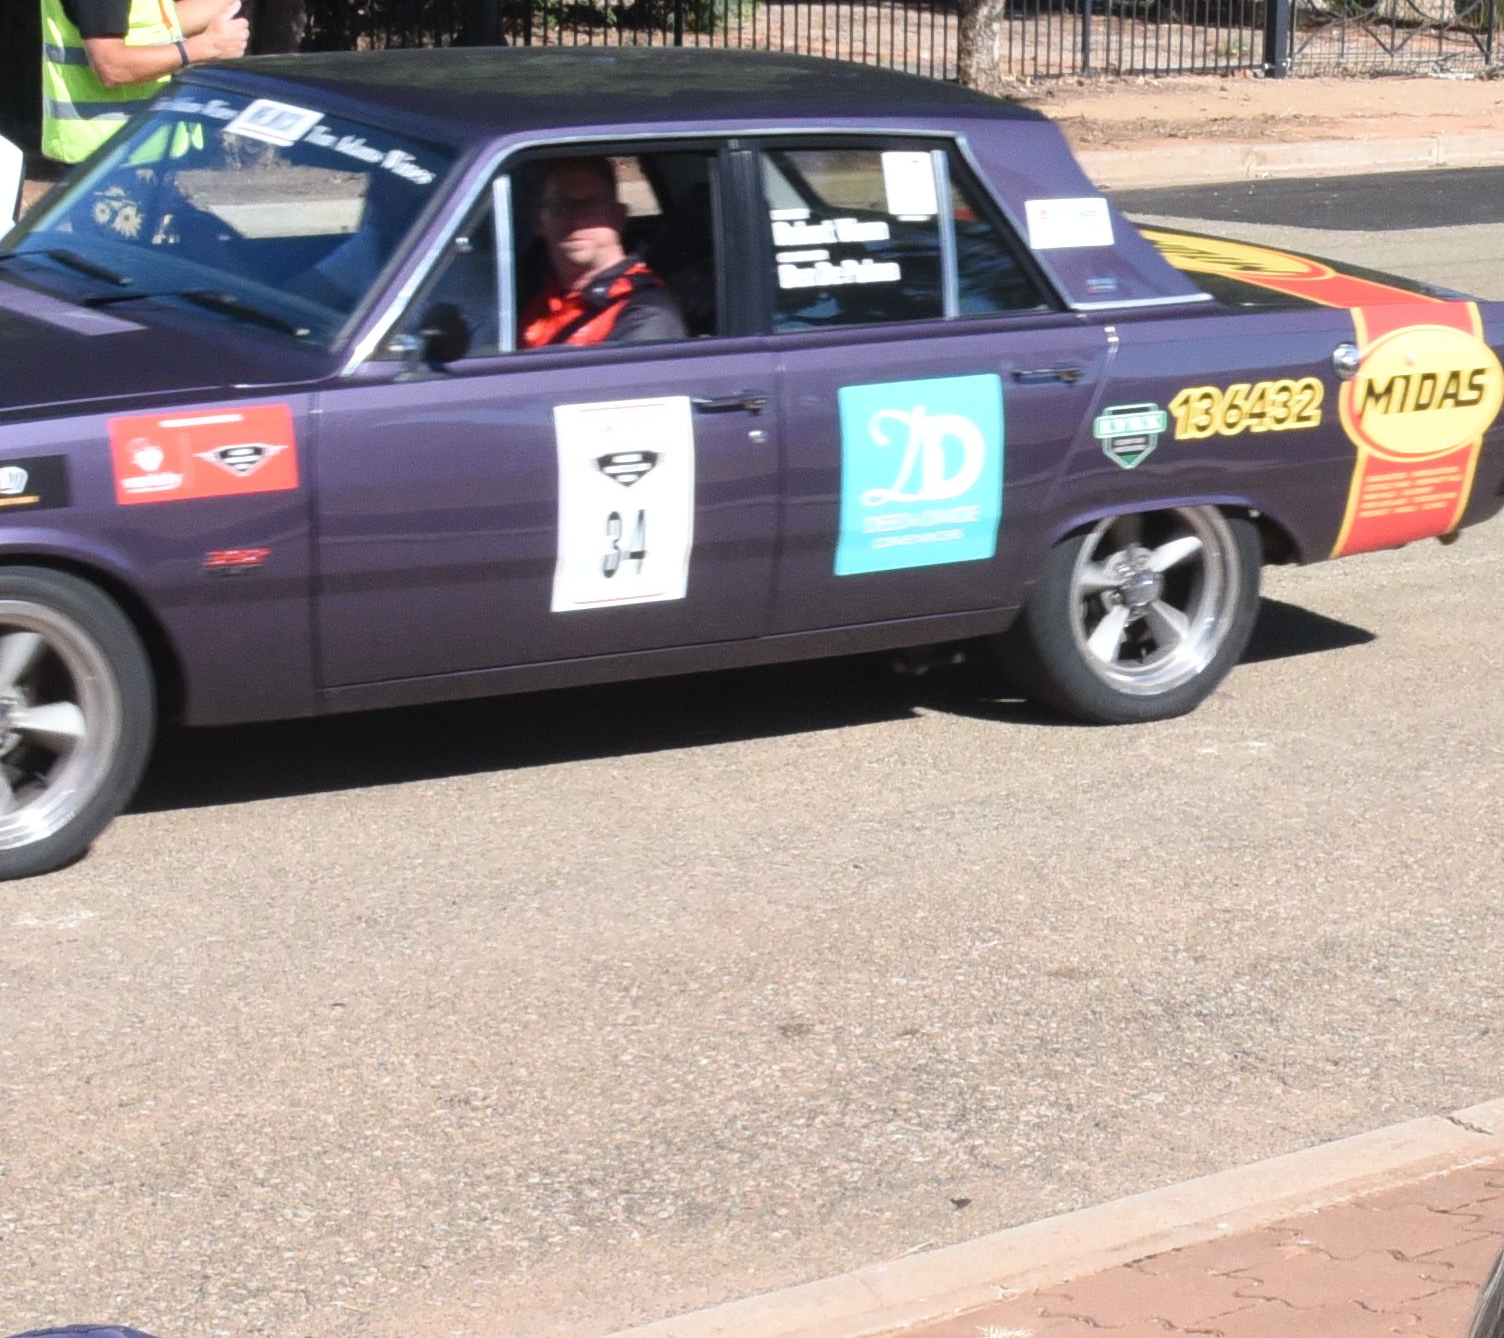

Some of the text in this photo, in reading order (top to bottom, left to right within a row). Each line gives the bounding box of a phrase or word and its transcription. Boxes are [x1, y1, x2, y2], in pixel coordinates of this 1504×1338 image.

[1170, 378, 1323, 439] 136432
[1360, 367, 1489, 418] MIDAS
[602, 509, 648, 579] 34
